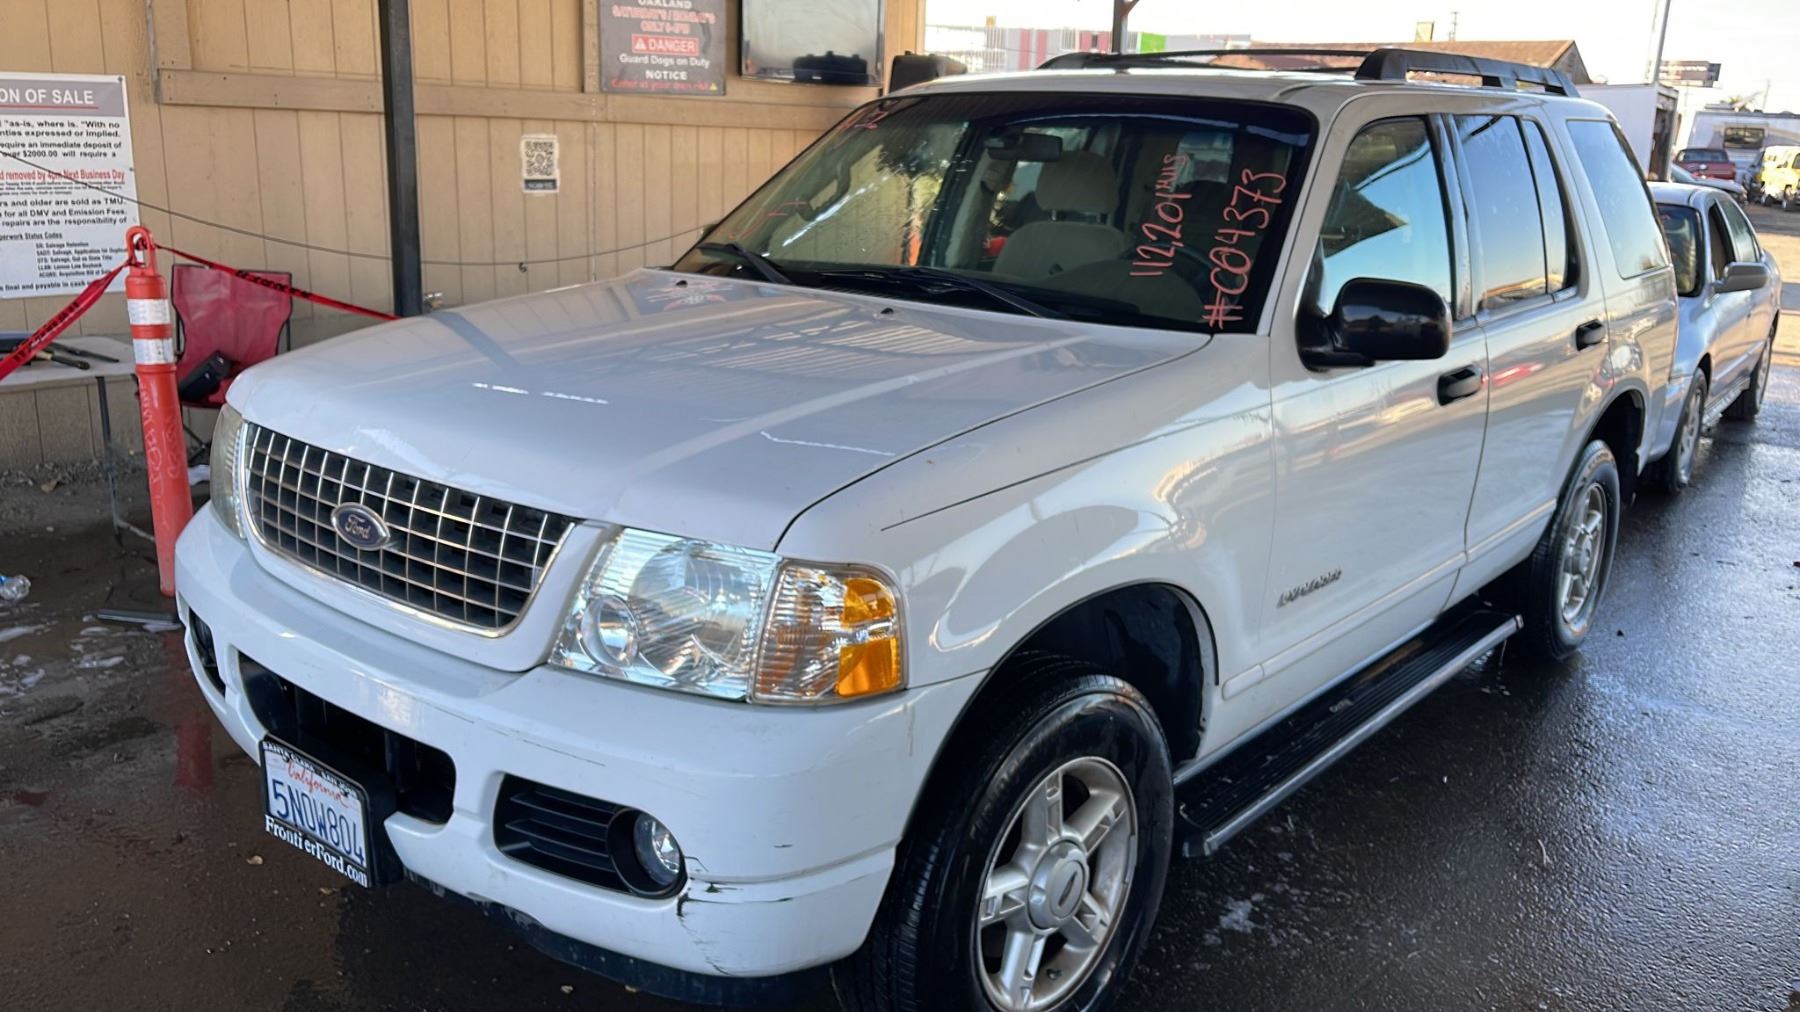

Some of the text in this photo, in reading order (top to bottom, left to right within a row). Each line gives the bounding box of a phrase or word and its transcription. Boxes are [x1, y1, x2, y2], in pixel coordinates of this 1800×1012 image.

[648, 39, 695, 52] DANGER
[619, 53, 649, 63] Guard
[650, 55, 674, 67] Dogs
[689, 57, 710, 69] Duty
[645, 70, 688, 80] NOTICE
[25, 89, 46, 104] OF
[52, 89, 95, 105] SALE
[37, 120, 64, 128] where
[25, 130, 72, 138] expressed
[86, 130, 120, 138] implied.
[40, 141, 81, 149] immediate
[83, 141, 112, 150] deposit
[113, 141, 122, 149] of
[23, 150, 58, 159] $2000.00
[80, 151, 107, 159] require
[5, 170, 36, 180] removed
[37, 171, 46, 182] by
[63, 169, 79, 180] Next
[80, 169, 111, 180] Business
[112, 169, 125, 182] Day
[30, 199, 52, 207] older
[4, 210, 16, 218] for
[18, 209, 28, 217] all
[30, 209, 49, 217] DMV
[52, 209, 67, 217] and
[68, 208, 105, 216] Emission
[2, 220, 31, 228] repairs
[48, 218, 61, 226] the
[64, 217, 117, 226] responsibility
[25, 232, 43, 240] Status
[45, 232, 63, 240] Codes
[5, 283, 20, 292] final
[22, 283, 34, 291] and
[35, 281, 61, 291] payable
[345, 514, 371, 539] Ford
[287, 758, 347, 806] California
